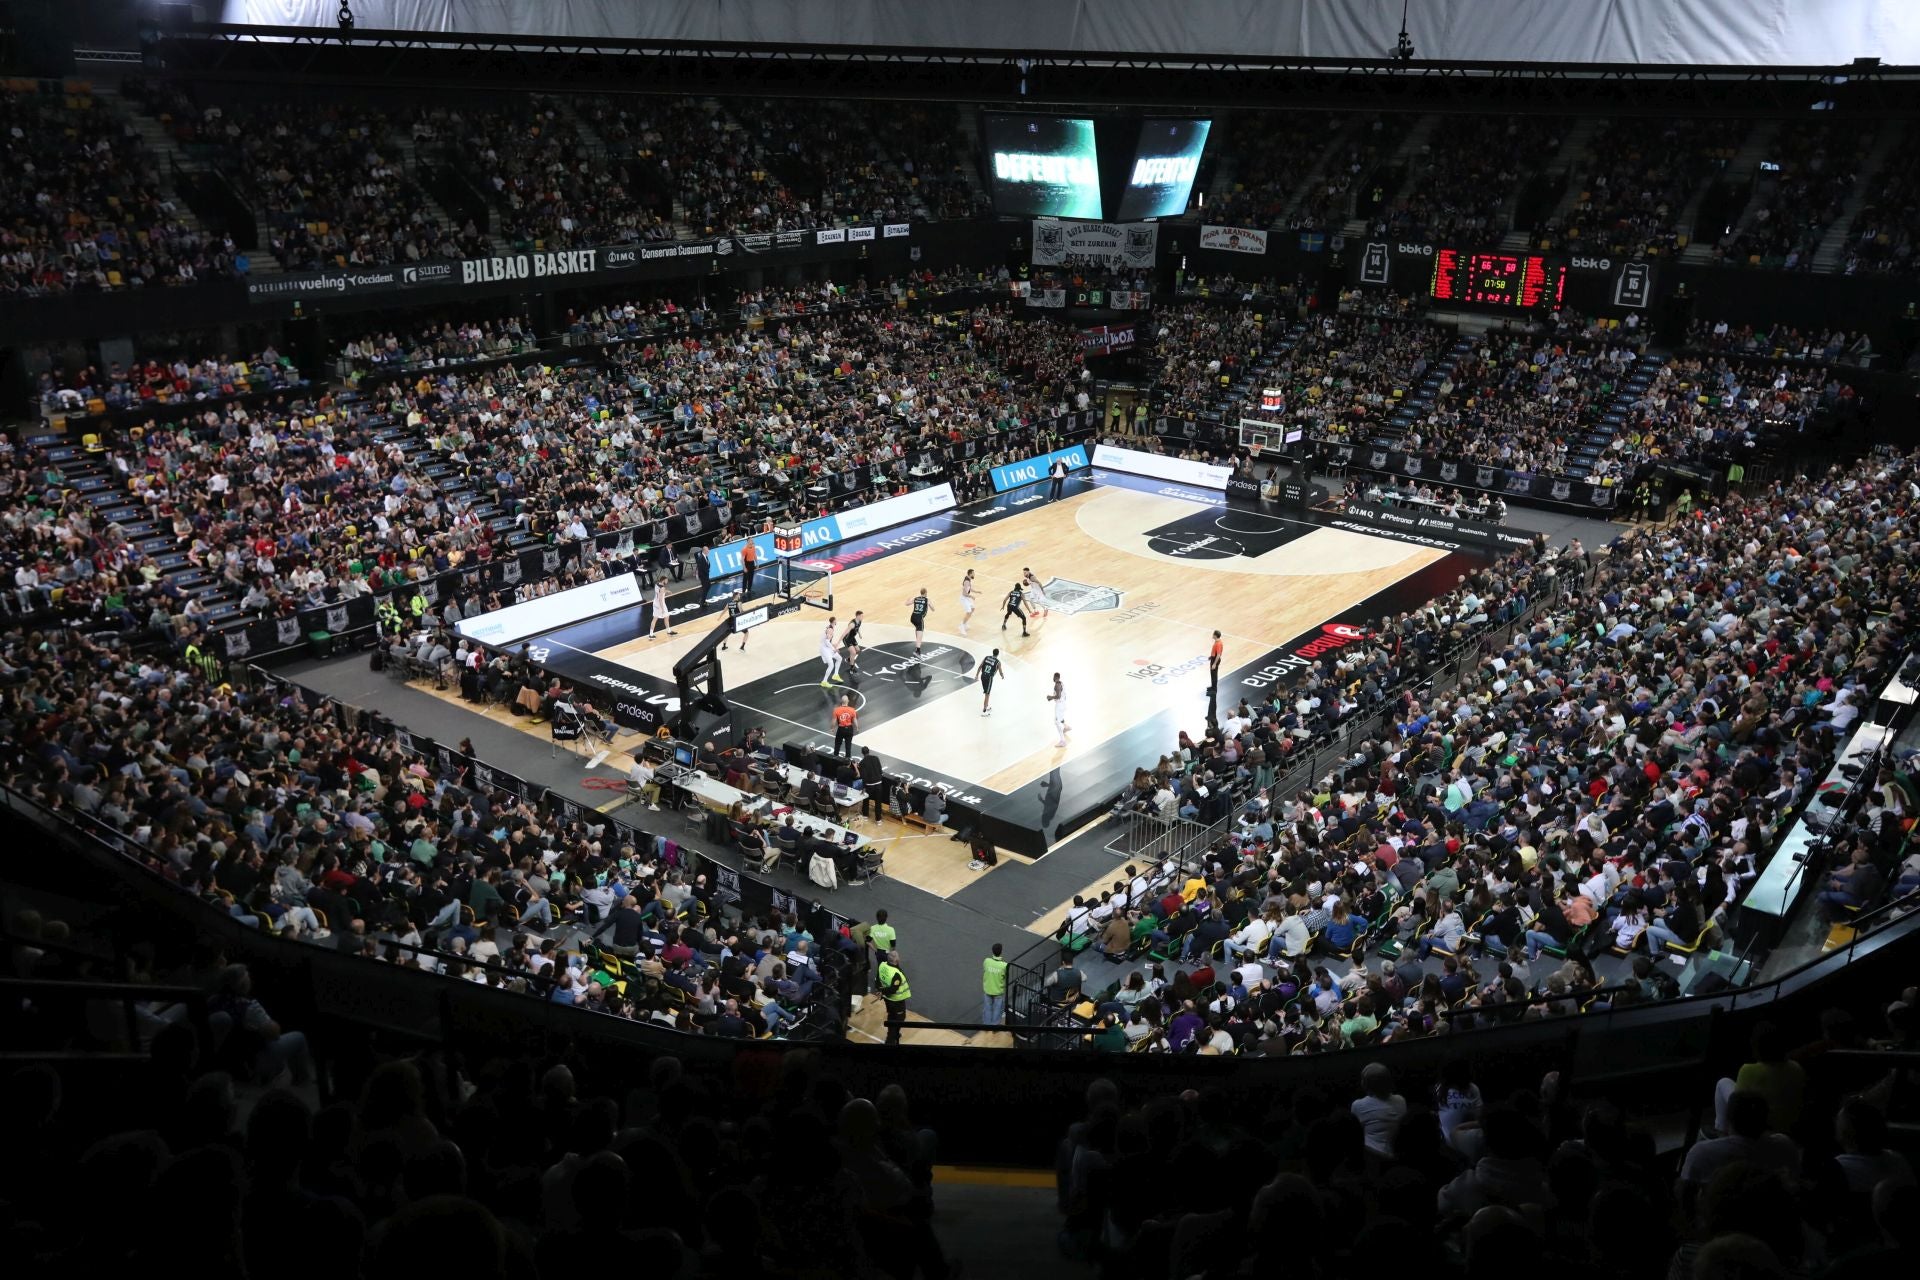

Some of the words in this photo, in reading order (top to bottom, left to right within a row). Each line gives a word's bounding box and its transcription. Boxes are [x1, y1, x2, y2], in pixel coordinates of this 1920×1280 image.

[1088, 240, 1117, 248] ZUREKIN
[1398, 243, 1422, 255] bbk
[616, 252, 636, 261] IMQ
[641, 247, 677, 260] Conservas
[678, 244, 714, 256] Cusumano
[1371, 254, 1381, 266] 14
[1481, 261, 1492, 270] 66
[1571, 257, 1598, 269] bbk
[418, 263, 451, 276] surne
[462, 255, 528, 284] BILBAO
[534, 250, 596, 278] BASKET
[298, 274, 345, 291] vueling
[357, 273, 394, 285] Occident
[1484, 279, 1506, 289] 07:58
[1628, 277, 1640, 290] 15
[1079, 294, 1086, 302] D
[1263, 397, 1274, 406] 19
[1010, 465, 1039, 484] IMQ
[1227, 478, 1258, 491] endesa
[1355, 509, 1374, 519] IMQ
[1388, 513, 1415, 525] Petronor
[1429, 519, 1454, 528] MEDRANO
[803, 526, 833, 546] MQ
[1331, 520, 1461, 549] #ligaendesa
[1458, 527, 1487, 537] azulmarino
[776, 537, 787, 550] 19
[790, 537, 801, 550] 19
[877, 528, 943, 550] Arena
[777, 605, 799, 616] endesa
[1108, 600, 1161, 624] surne
[737, 612, 763, 627] kutxabank
[693, 669, 709, 682] vueling
[985, 665, 992, 673] 12
[1125, 662, 1165, 681] liga
[1151, 654, 1209, 686] endesa
[1240, 652, 1313, 688] Arena
[590, 674, 650, 696] Movistar
[616, 701, 654, 723] endesa
[712, 724, 731, 737] vueling
[385, 870, 395, 883] 4
